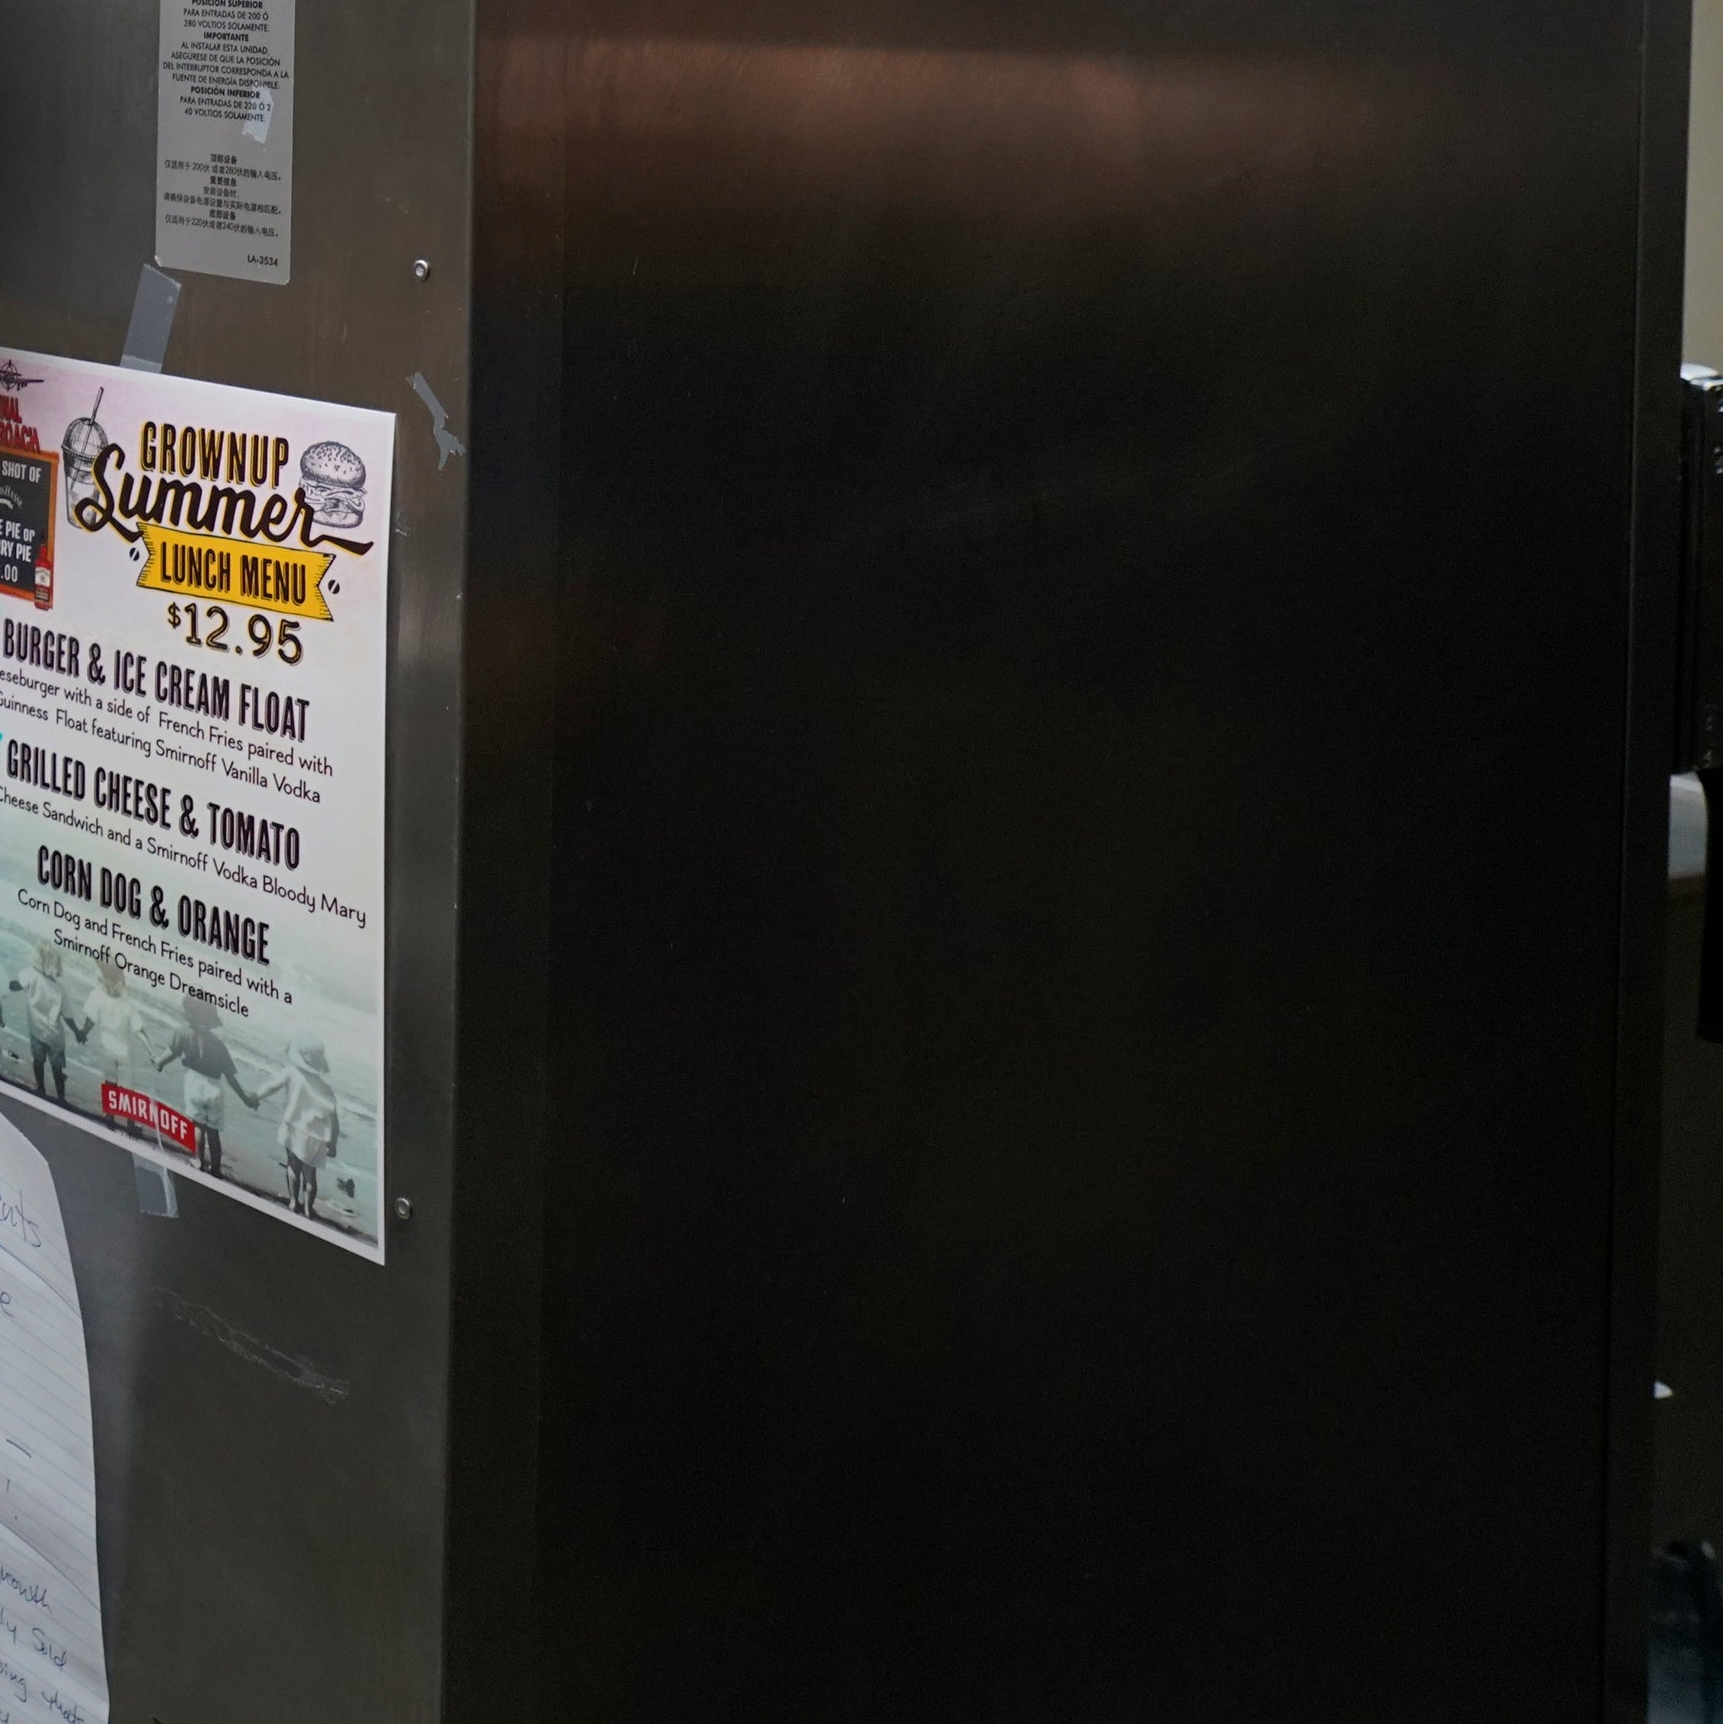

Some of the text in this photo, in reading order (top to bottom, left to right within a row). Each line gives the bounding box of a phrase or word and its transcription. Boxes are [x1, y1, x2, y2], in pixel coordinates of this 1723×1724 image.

[247, 254, 278, 267] LA-3534
[2, 460, 27, 480] SHOT
[29, 466, 41, 483] OF
[140, 421, 289, 488] GROWNUP
[5, 520, 21, 540] PIE
[74, 441, 375, 557] Summer
[16, 543, 32, 562] PIE
[161, 541, 309, 606] LUNCH MENU
[166, 601, 303, 666] $12.95
[3, 618, 310, 743] BURGER & ICE CREAM FLOAT
[56, 708, 88, 733] Float
[91, 718, 151, 758] featuring
[155, 739, 217, 772] Smirnoff
[221, 758, 268, 788] Vanilla
[273, 773, 320, 803] Vodka
[64, 687, 92, 706] with
[107, 698, 133, 719] side
[136, 705, 151, 723] of
[159, 711, 205, 740] French
[209, 725, 243, 751] Fries
[248, 742, 294, 766] paired
[299, 755, 333, 777] with
[7, 739, 300, 871] GRILLED CHEESE & TOMATO
[37, 845, 270, 966] CORN DOG & ORANGE
[42, 801, 103, 836] Sandwich
[107, 828, 131, 846] and
[147, 836, 208, 872] Smirnoff
[212, 858, 258, 889] Vodka
[263, 874, 315, 913] Bloody
[321, 893, 366, 929] Mary
[18, 888, 50, 914] Corn
[48, 900, 81, 931] Dog
[84, 918, 108, 936] and
[112, 922, 156, 954] French
[161, 940, 194, 968] Fries
[198, 960, 242, 986] paired
[246, 977, 279, 999] with
[54, 930, 249, 1018] Smirnoff Orange Dreamsicle
[108, 1090, 189, 1141] SMIRNOFF
